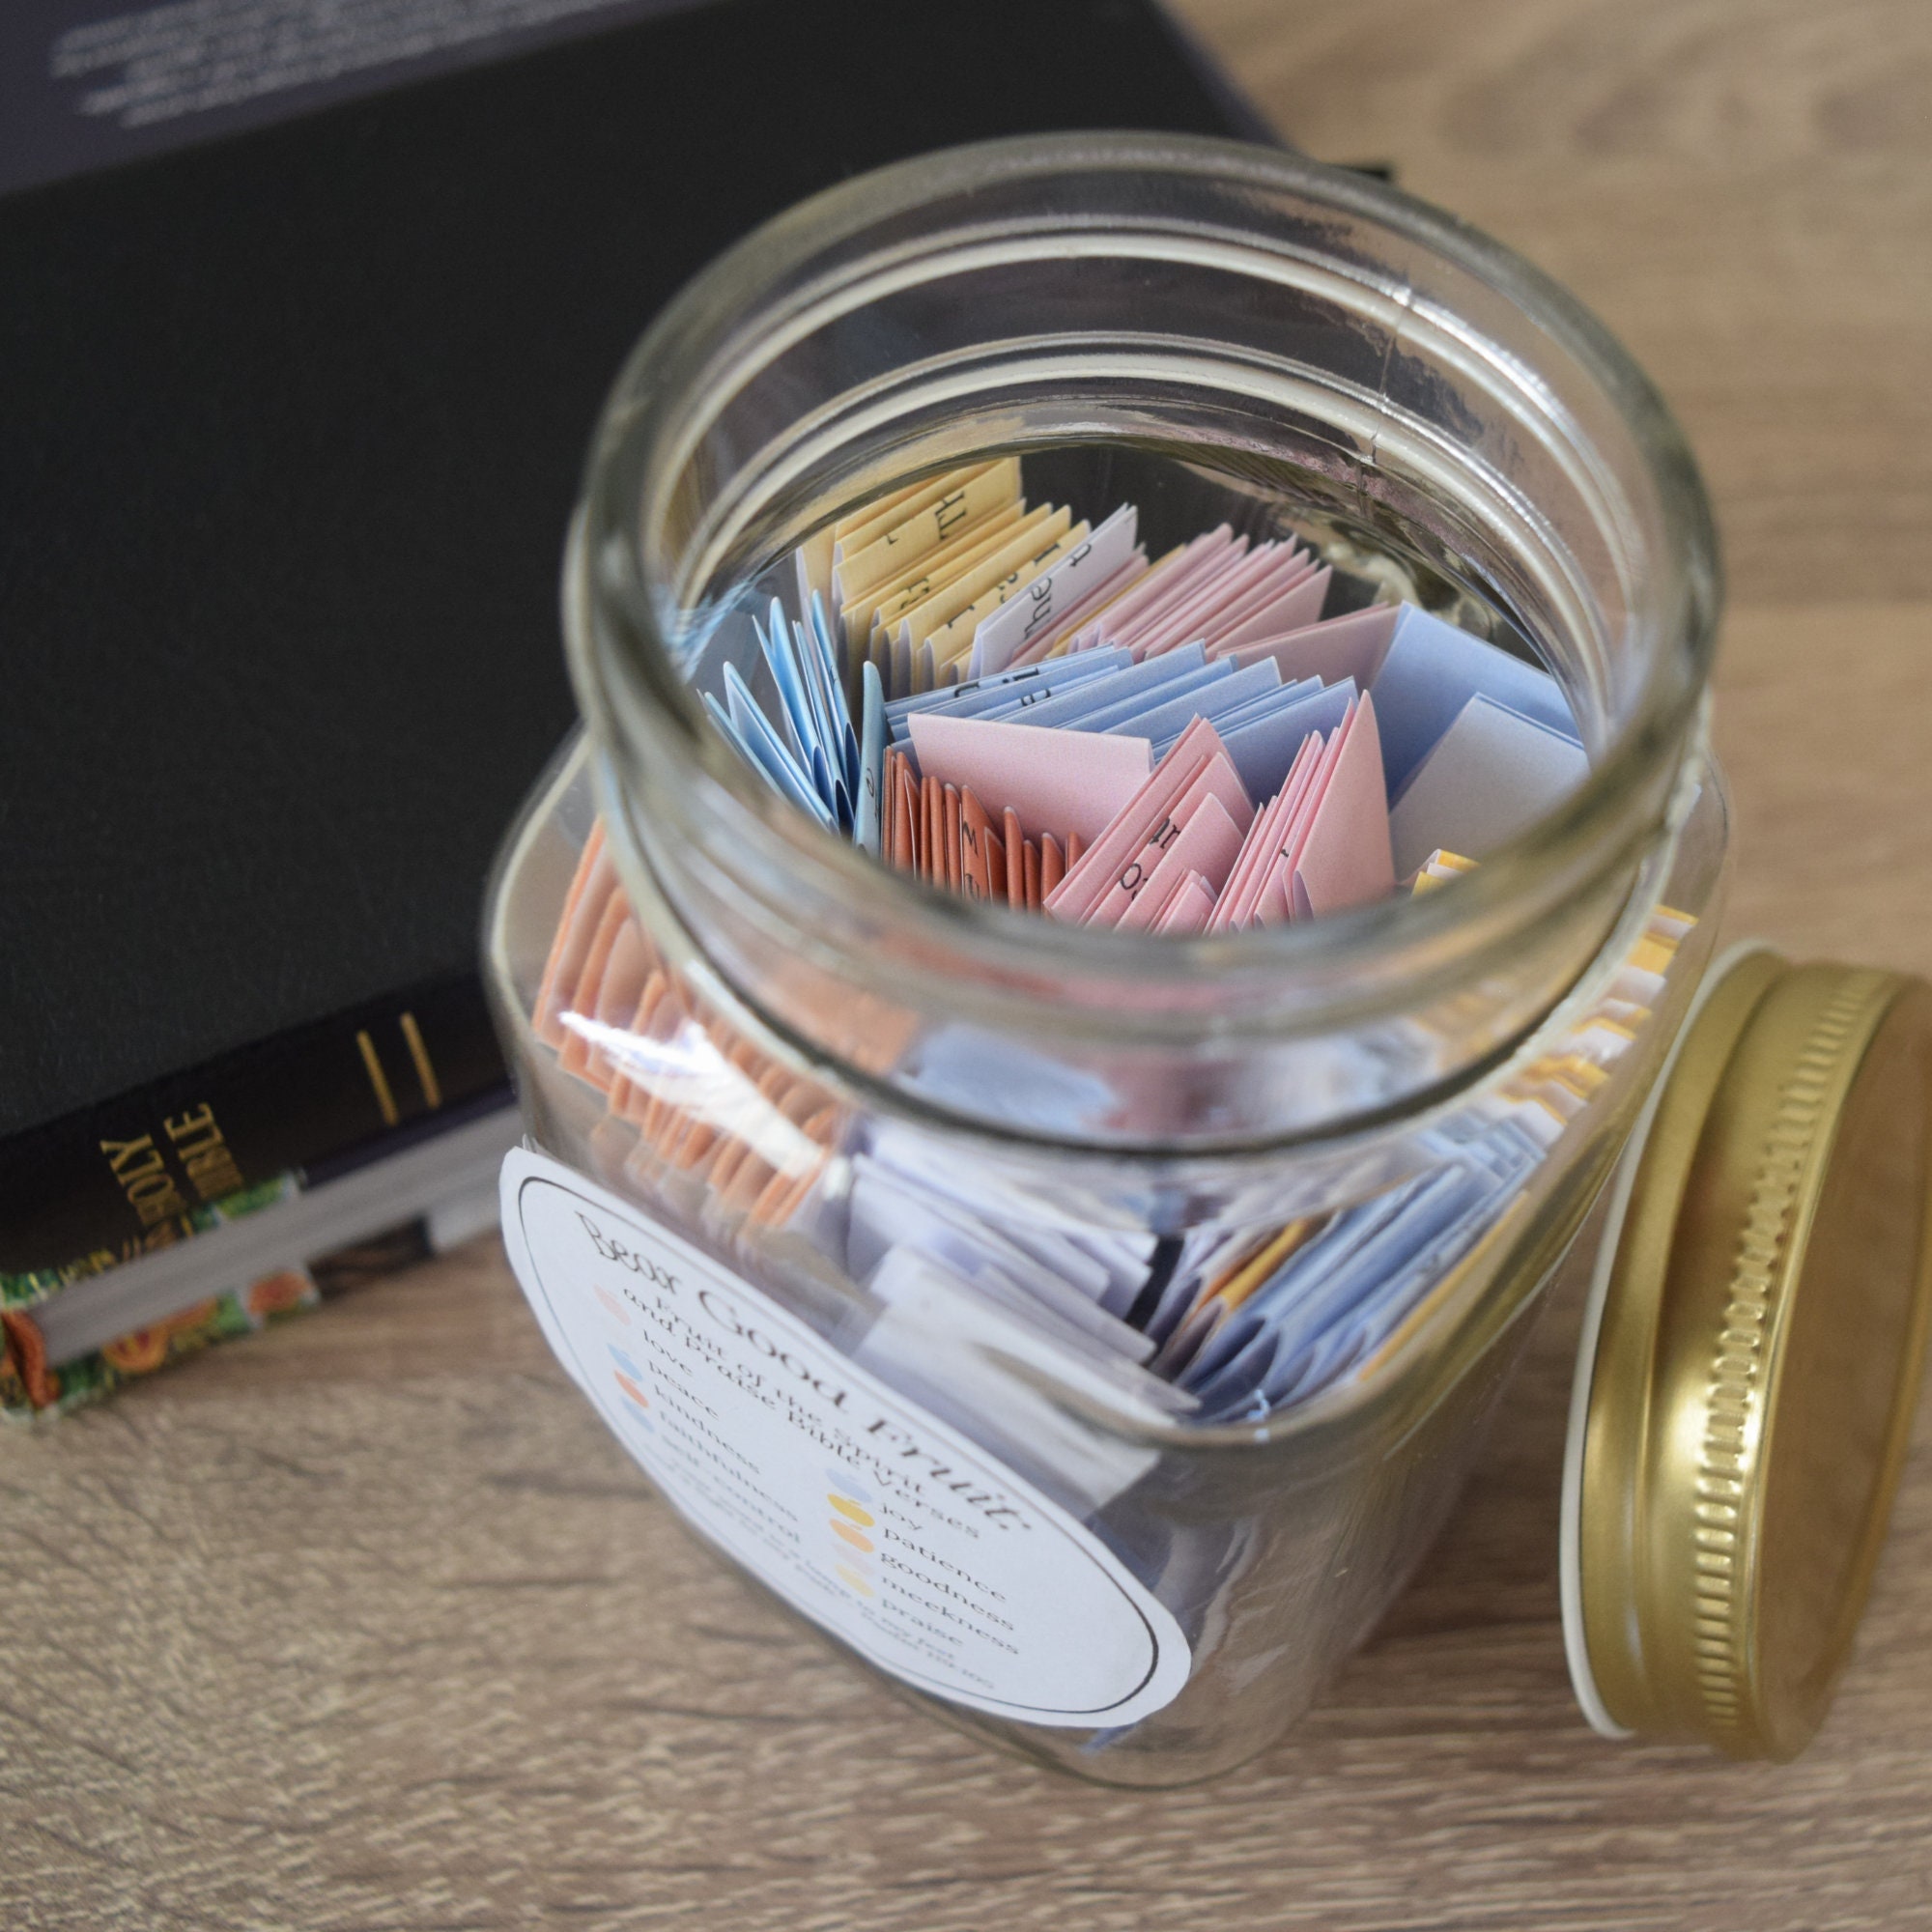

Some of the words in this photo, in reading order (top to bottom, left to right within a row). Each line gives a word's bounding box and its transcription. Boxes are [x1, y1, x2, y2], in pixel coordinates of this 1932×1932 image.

[574, 1211, 682, 1294] Bear
[697, 1289, 849, 1413] Good
[642, 1328, 694, 1378] love
[648, 1358, 720, 1422] peace
[623, 1287, 676, 1337] and
[787, 1409, 861, 1470] Bible
[872, 1467, 980, 1538] Verses
[653, 1382, 761, 1475] kindness
[654, 1295, 726, 1361] Fruit
[736, 1362, 765, 1389] of
[775, 1387, 824, 1425] the
[833, 1428, 923, 1495] Spirit
[658, 1409, 799, 1523] faithfulness
[879, 1502, 923, 1532] joy
[880, 1551, 1015, 1633] goodness
[883, 1526, 1008, 1602] patience
[881, 1577, 1020, 1656] meekness
[881, 1597, 964, 1647] praise
